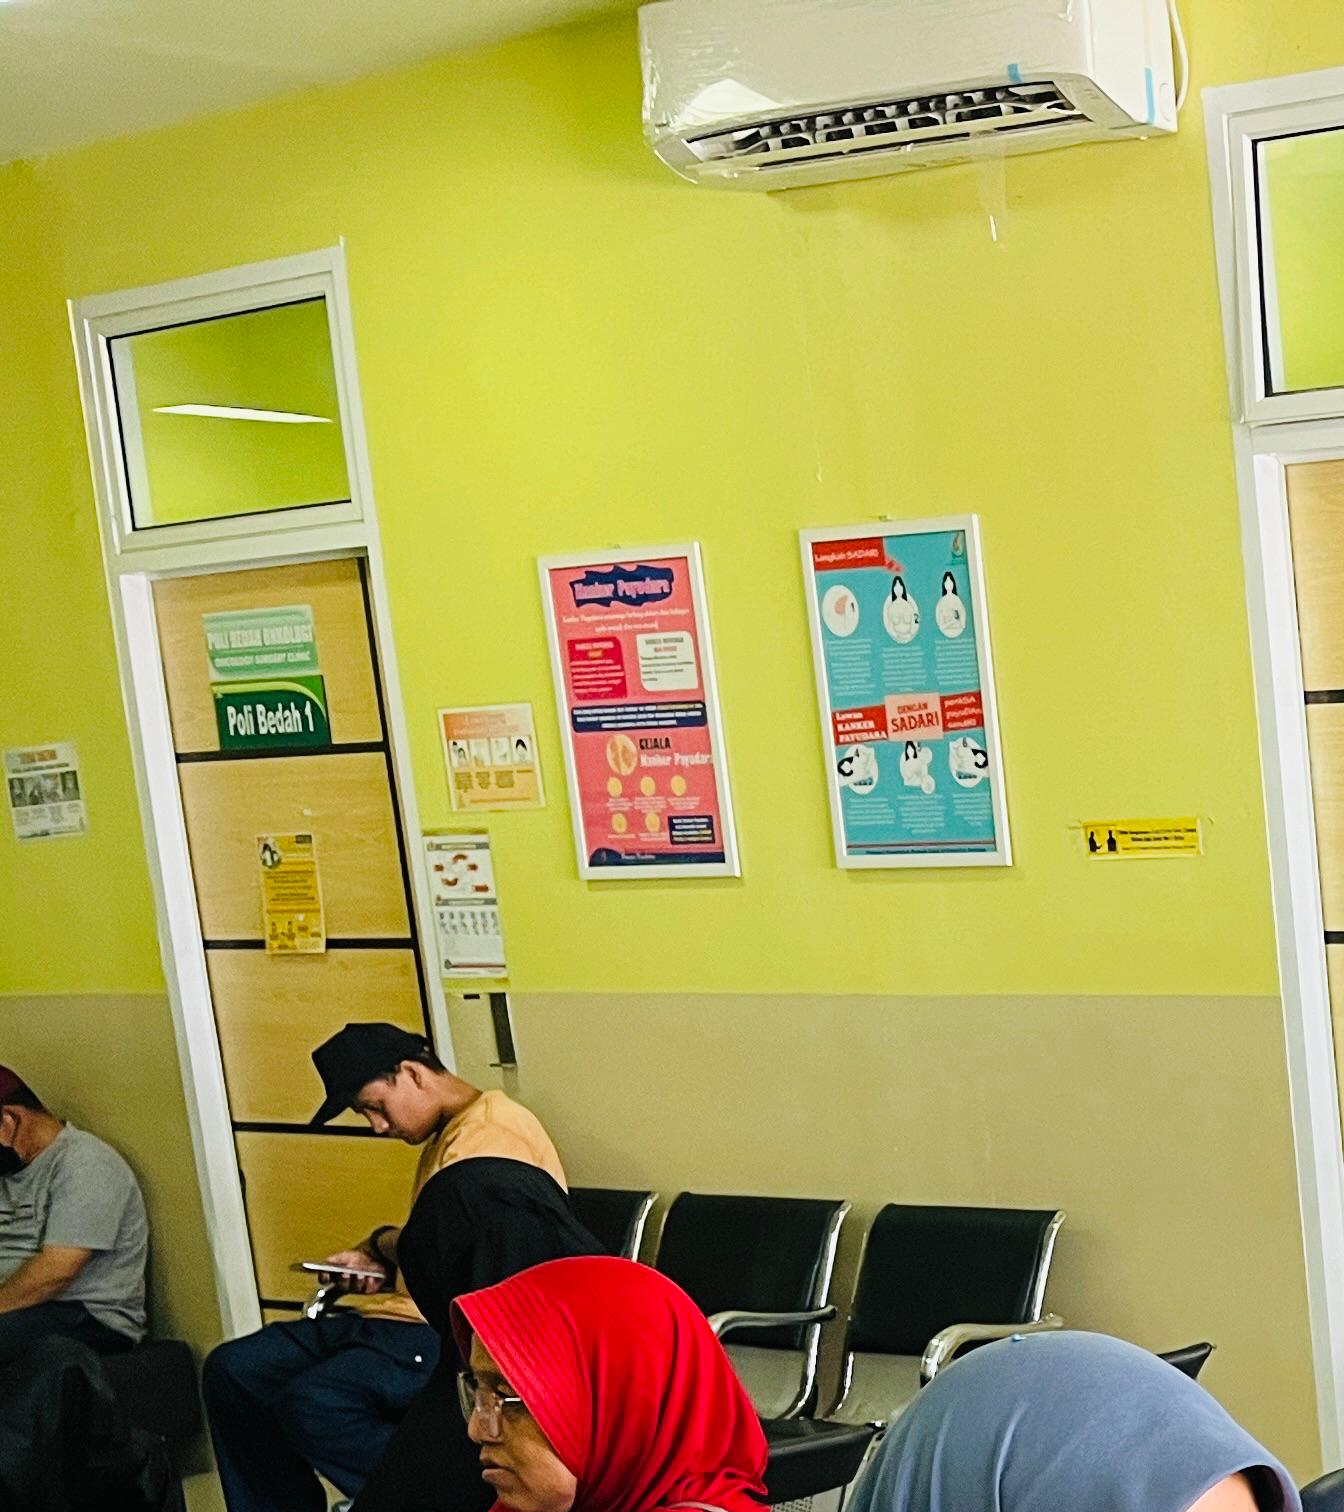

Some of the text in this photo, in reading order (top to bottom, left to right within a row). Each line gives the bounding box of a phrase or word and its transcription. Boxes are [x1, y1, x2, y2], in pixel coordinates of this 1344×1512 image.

[226, 700, 315, 736] Poli Bedah 1
[891, 712, 939, 732] SADARI
